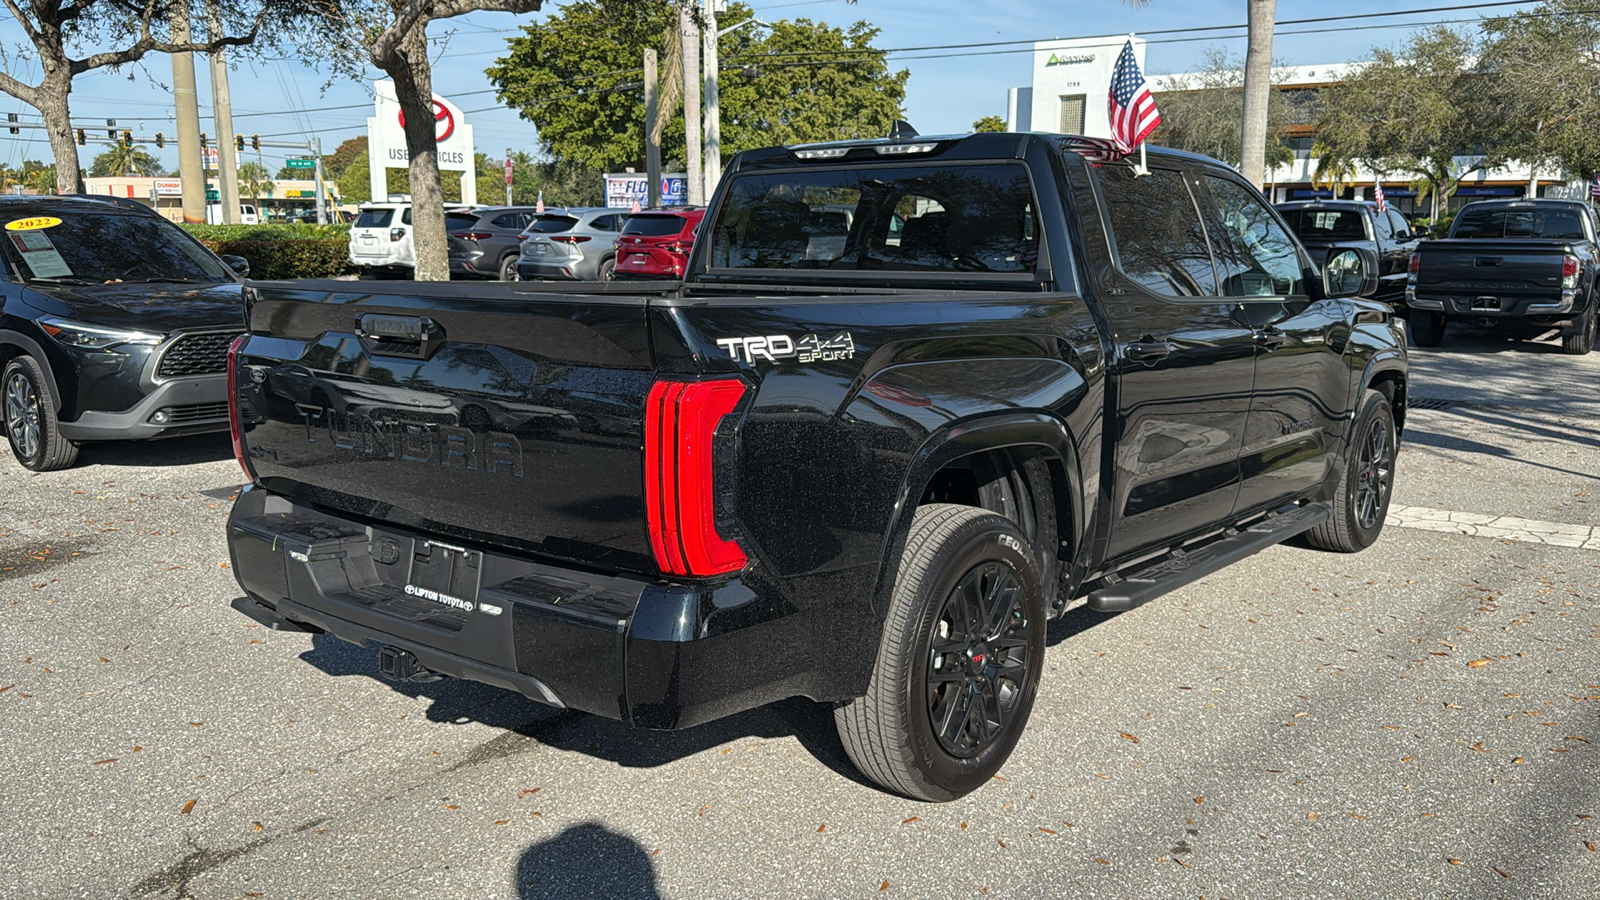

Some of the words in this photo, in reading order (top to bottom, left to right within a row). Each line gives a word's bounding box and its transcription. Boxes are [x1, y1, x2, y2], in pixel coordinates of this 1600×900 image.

[389, 148, 410, 160] USE
[17, 218, 51, 229] 2022
[716, 335, 796, 367] TRD
[799, 350, 854, 363] SPORT
[295, 402, 523, 478] TUNDRA
[414, 586, 438, 601] LIPTON
[438, 593, 464, 609] TOYOTA
